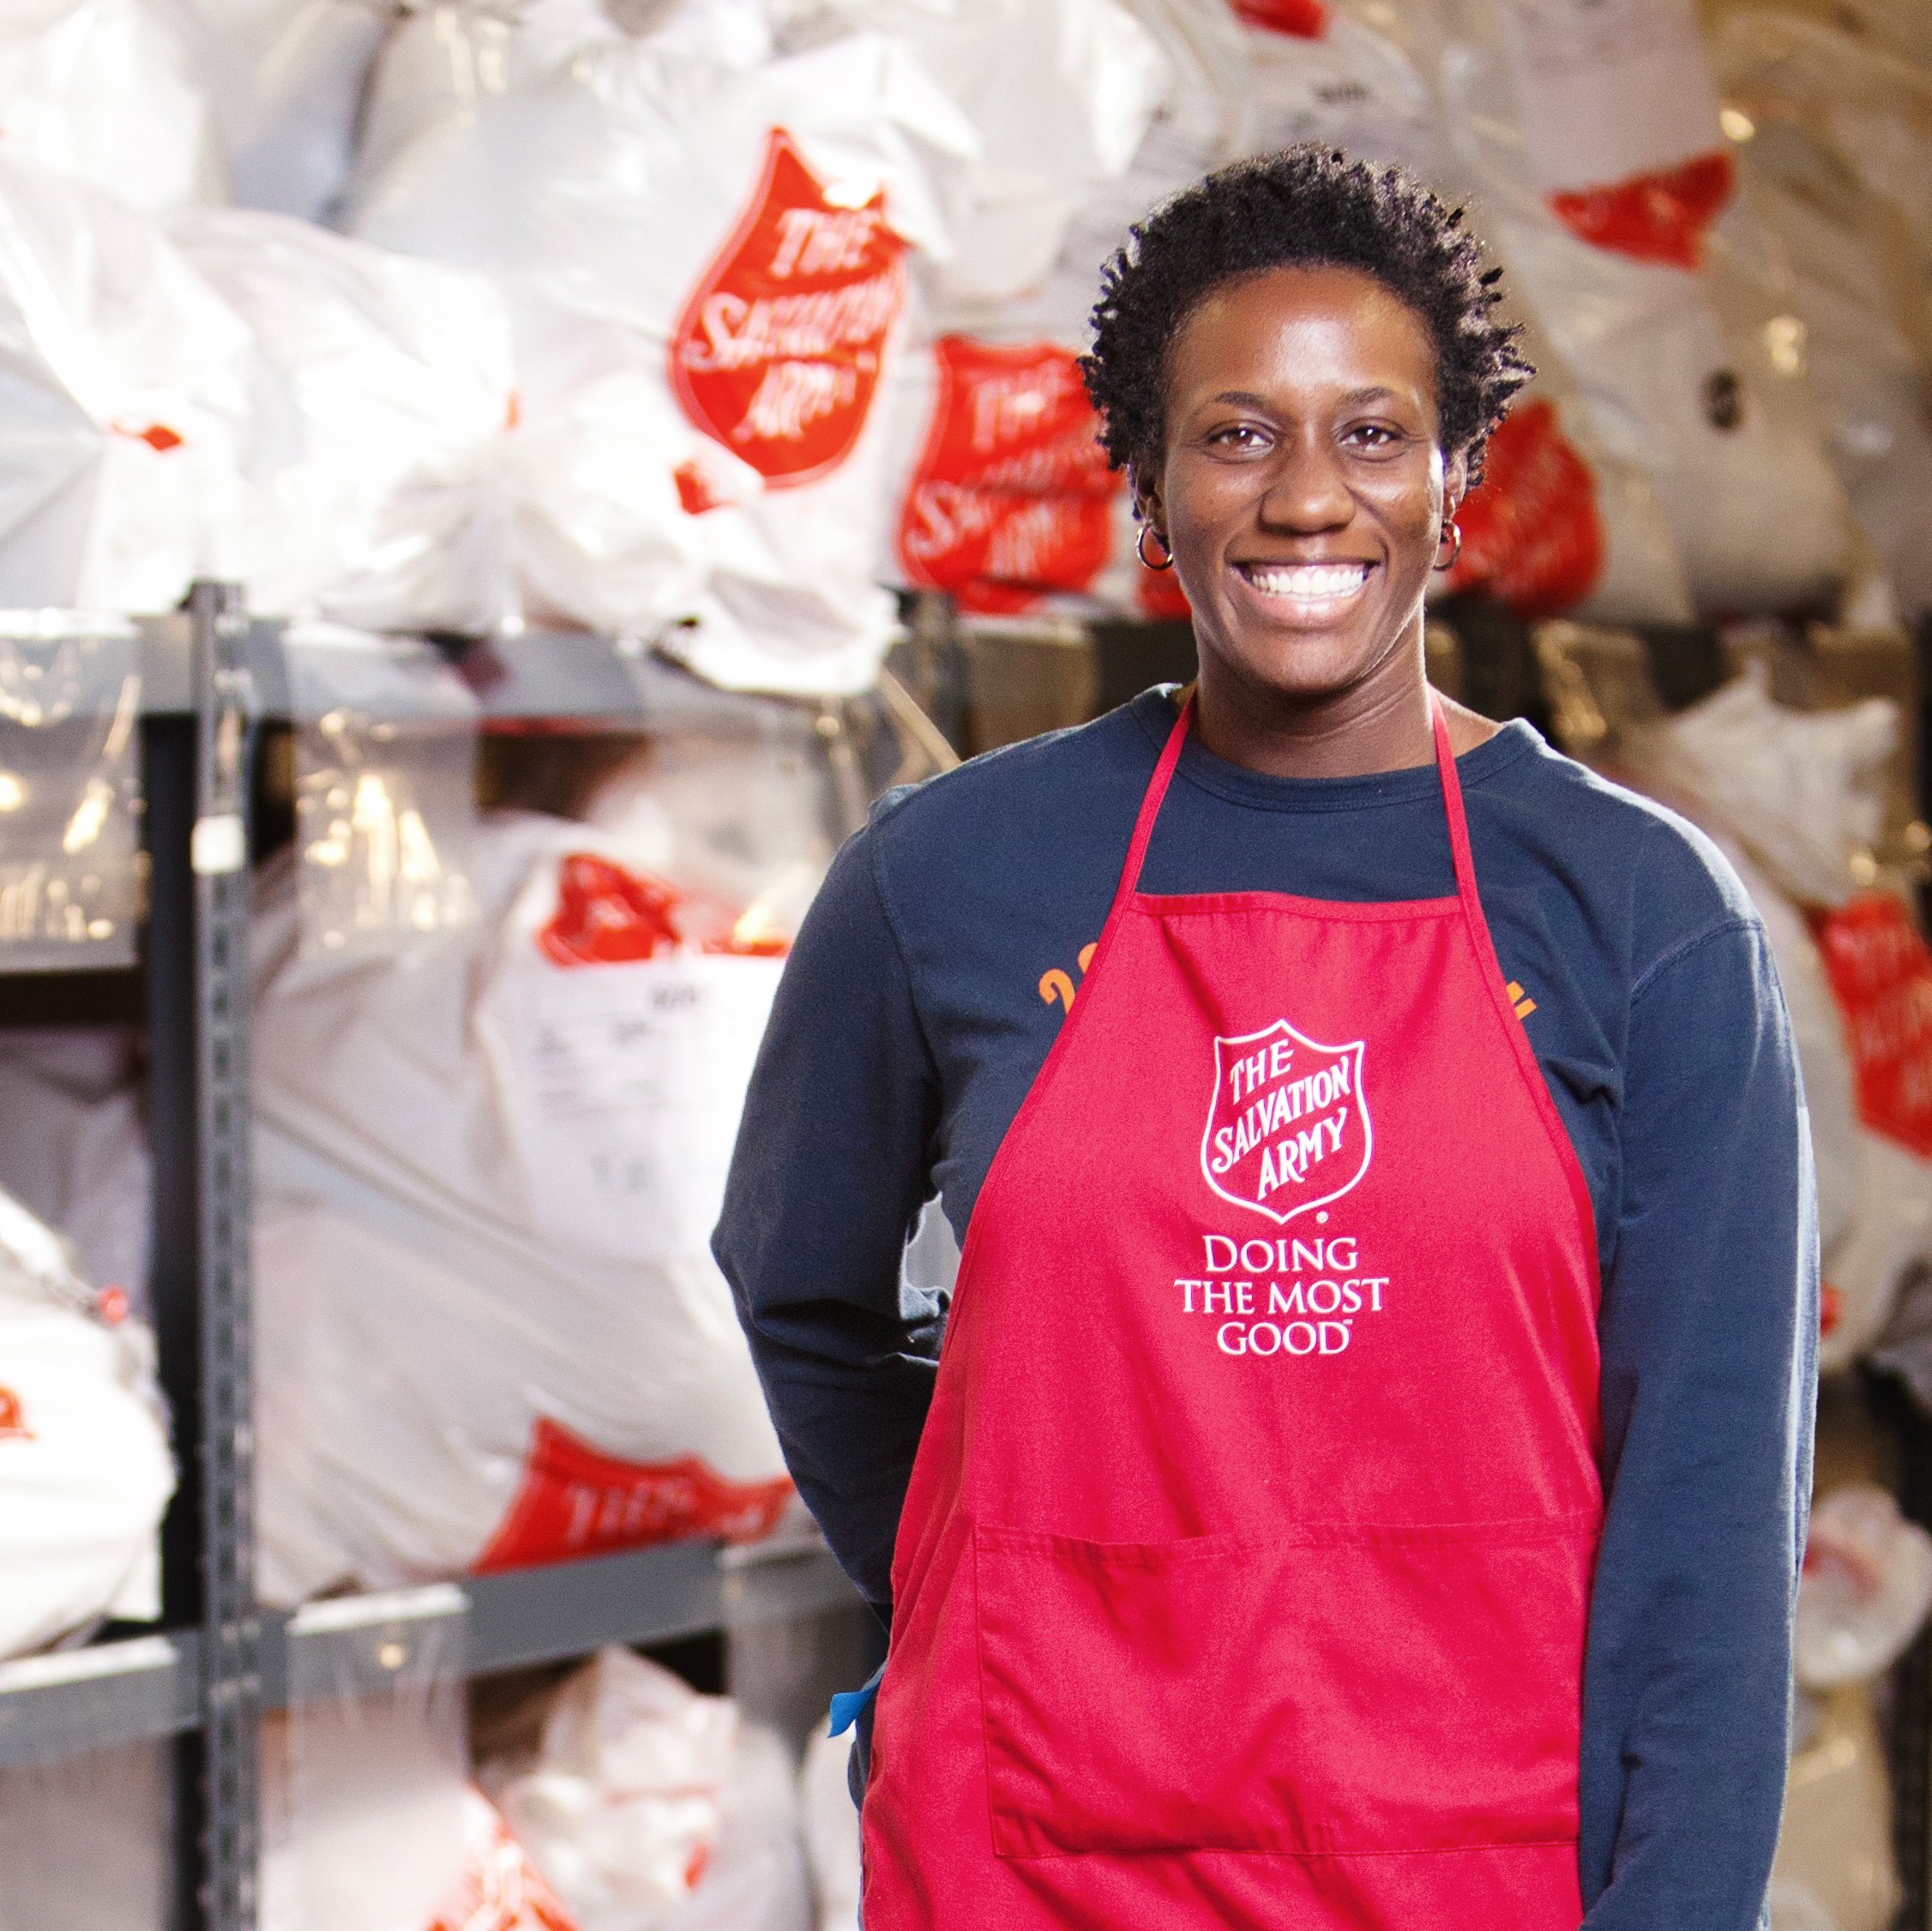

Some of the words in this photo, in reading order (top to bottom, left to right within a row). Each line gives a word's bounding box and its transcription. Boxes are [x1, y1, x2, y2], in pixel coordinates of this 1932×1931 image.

[1230, 1038, 1294, 1105] THE
[1211, 1055, 1352, 1174] SALVATION
[1257, 1106, 1349, 1201] ARMY
[1202, 1235, 1358, 1272] DOING
[1173, 1278, 1255, 1314] THE
[1267, 1277, 1390, 1314] MOST
[1216, 1320, 1350, 1356] GOOD
